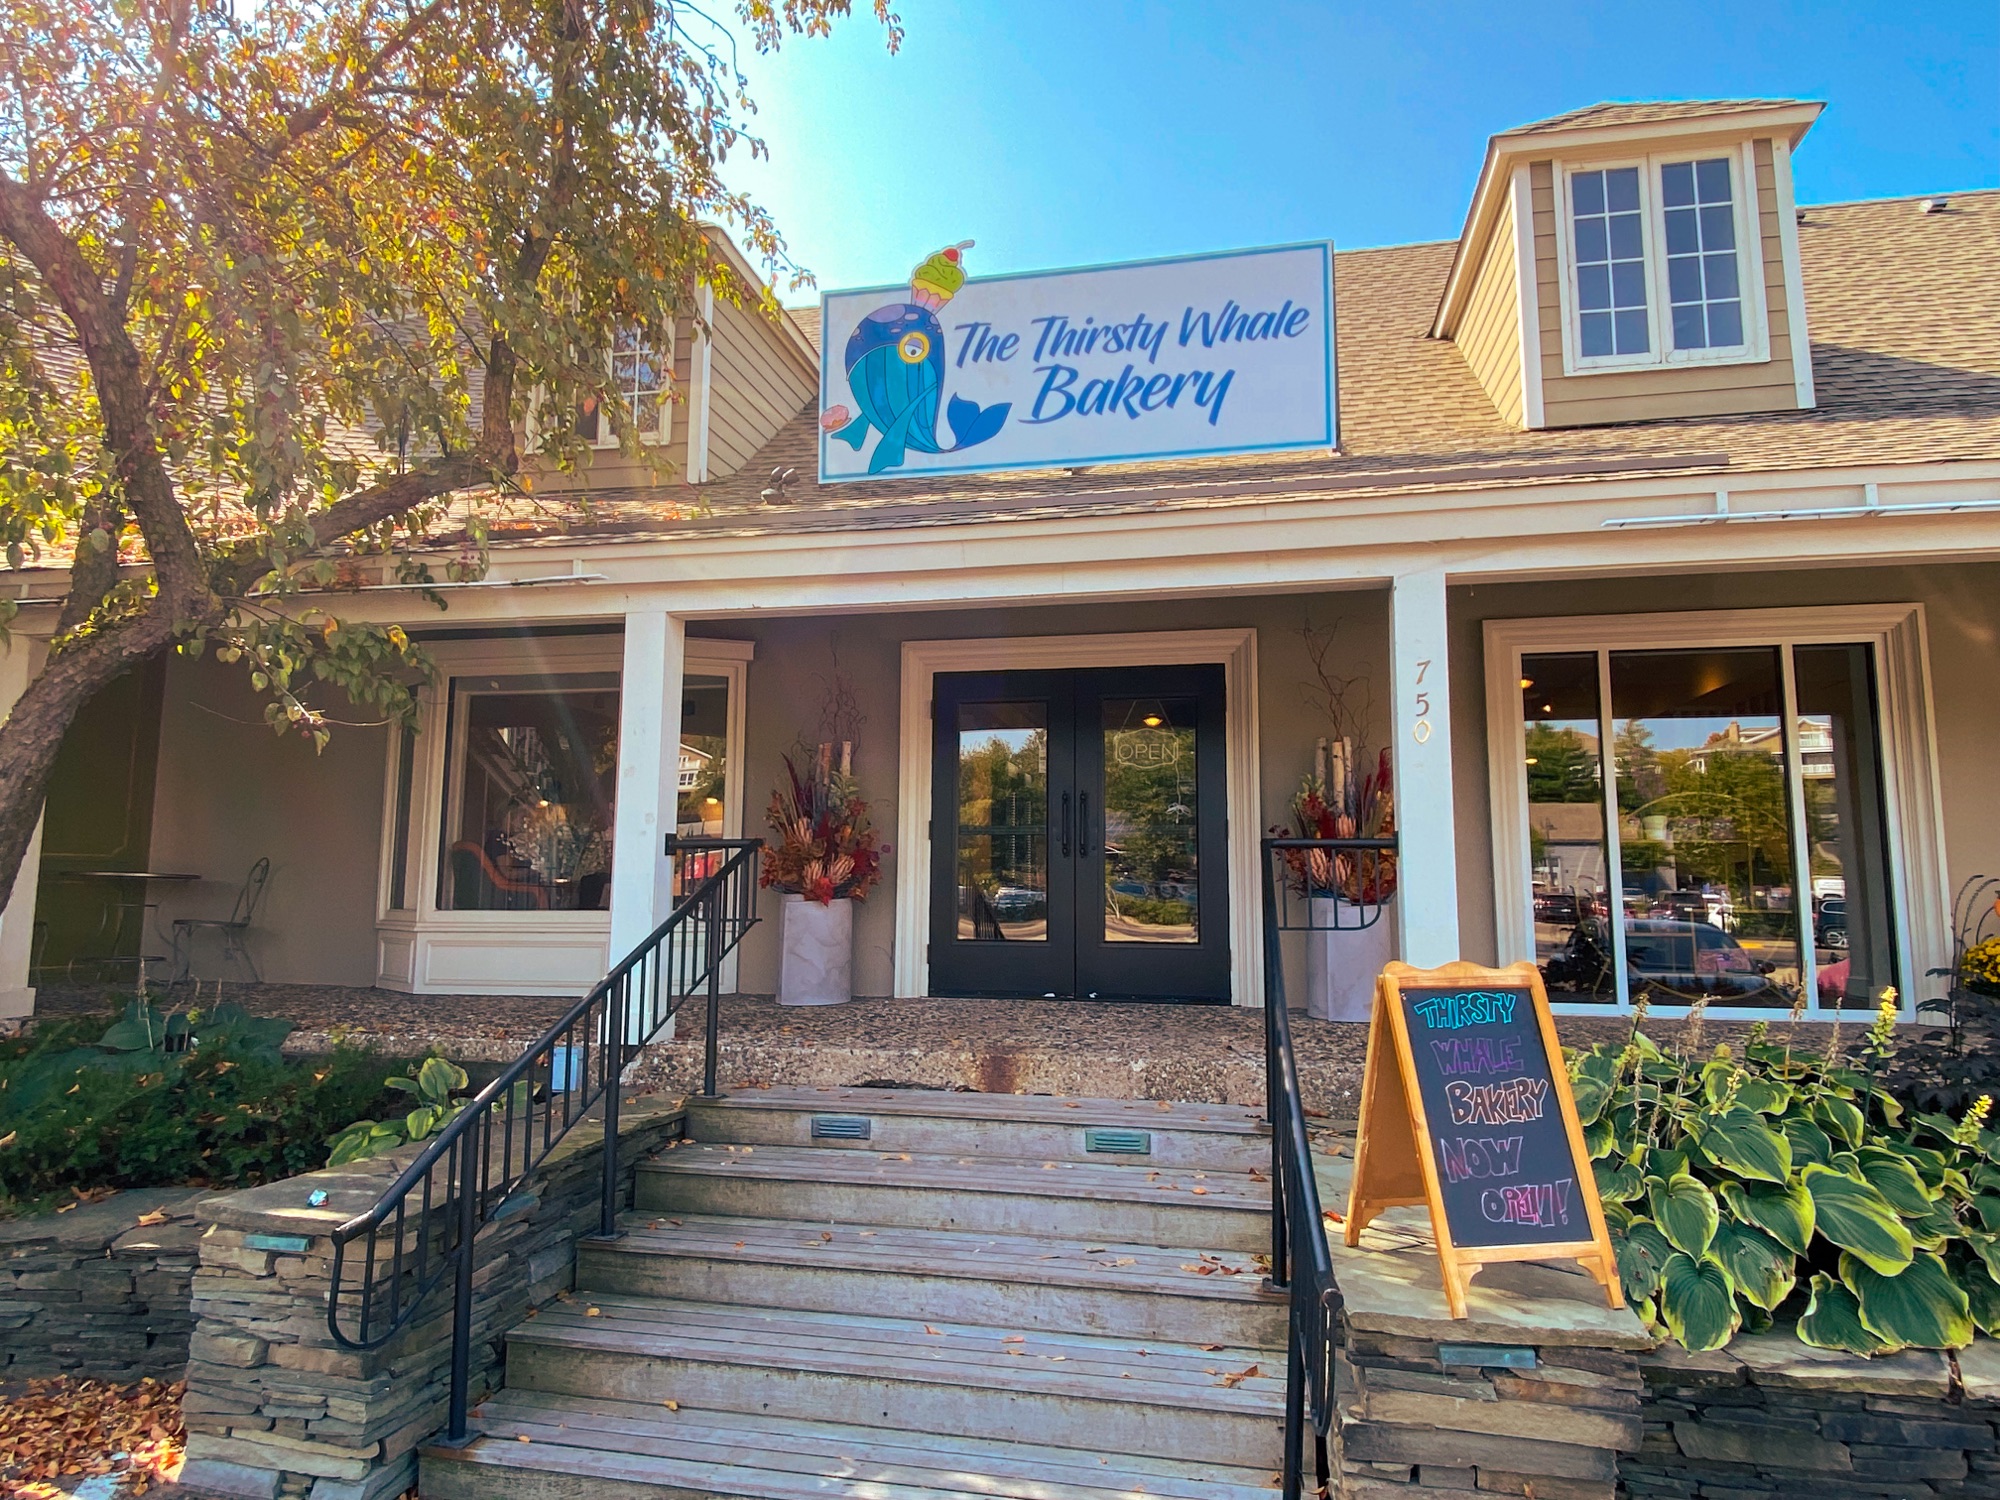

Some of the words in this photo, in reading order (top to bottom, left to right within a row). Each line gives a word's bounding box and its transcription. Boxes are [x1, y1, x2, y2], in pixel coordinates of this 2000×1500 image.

[954, 320, 1019, 369] The
[1031, 313, 1168, 363] Thirsty
[1178, 300, 1310, 348] Whale
[1018, 364, 1236, 426] Bakery
[1413, 659, 1432, 745] 750
[1117, 743, 1177, 761] OPEN
[1414, 992, 1516, 1029] THIRSTY
[1430, 1035, 1525, 1075] WHALE
[1445, 1077, 1548, 1125] BAKERY
[1440, 1136, 1523, 1183] NOW
[1481, 1178, 1572, 1227] OPEN!
